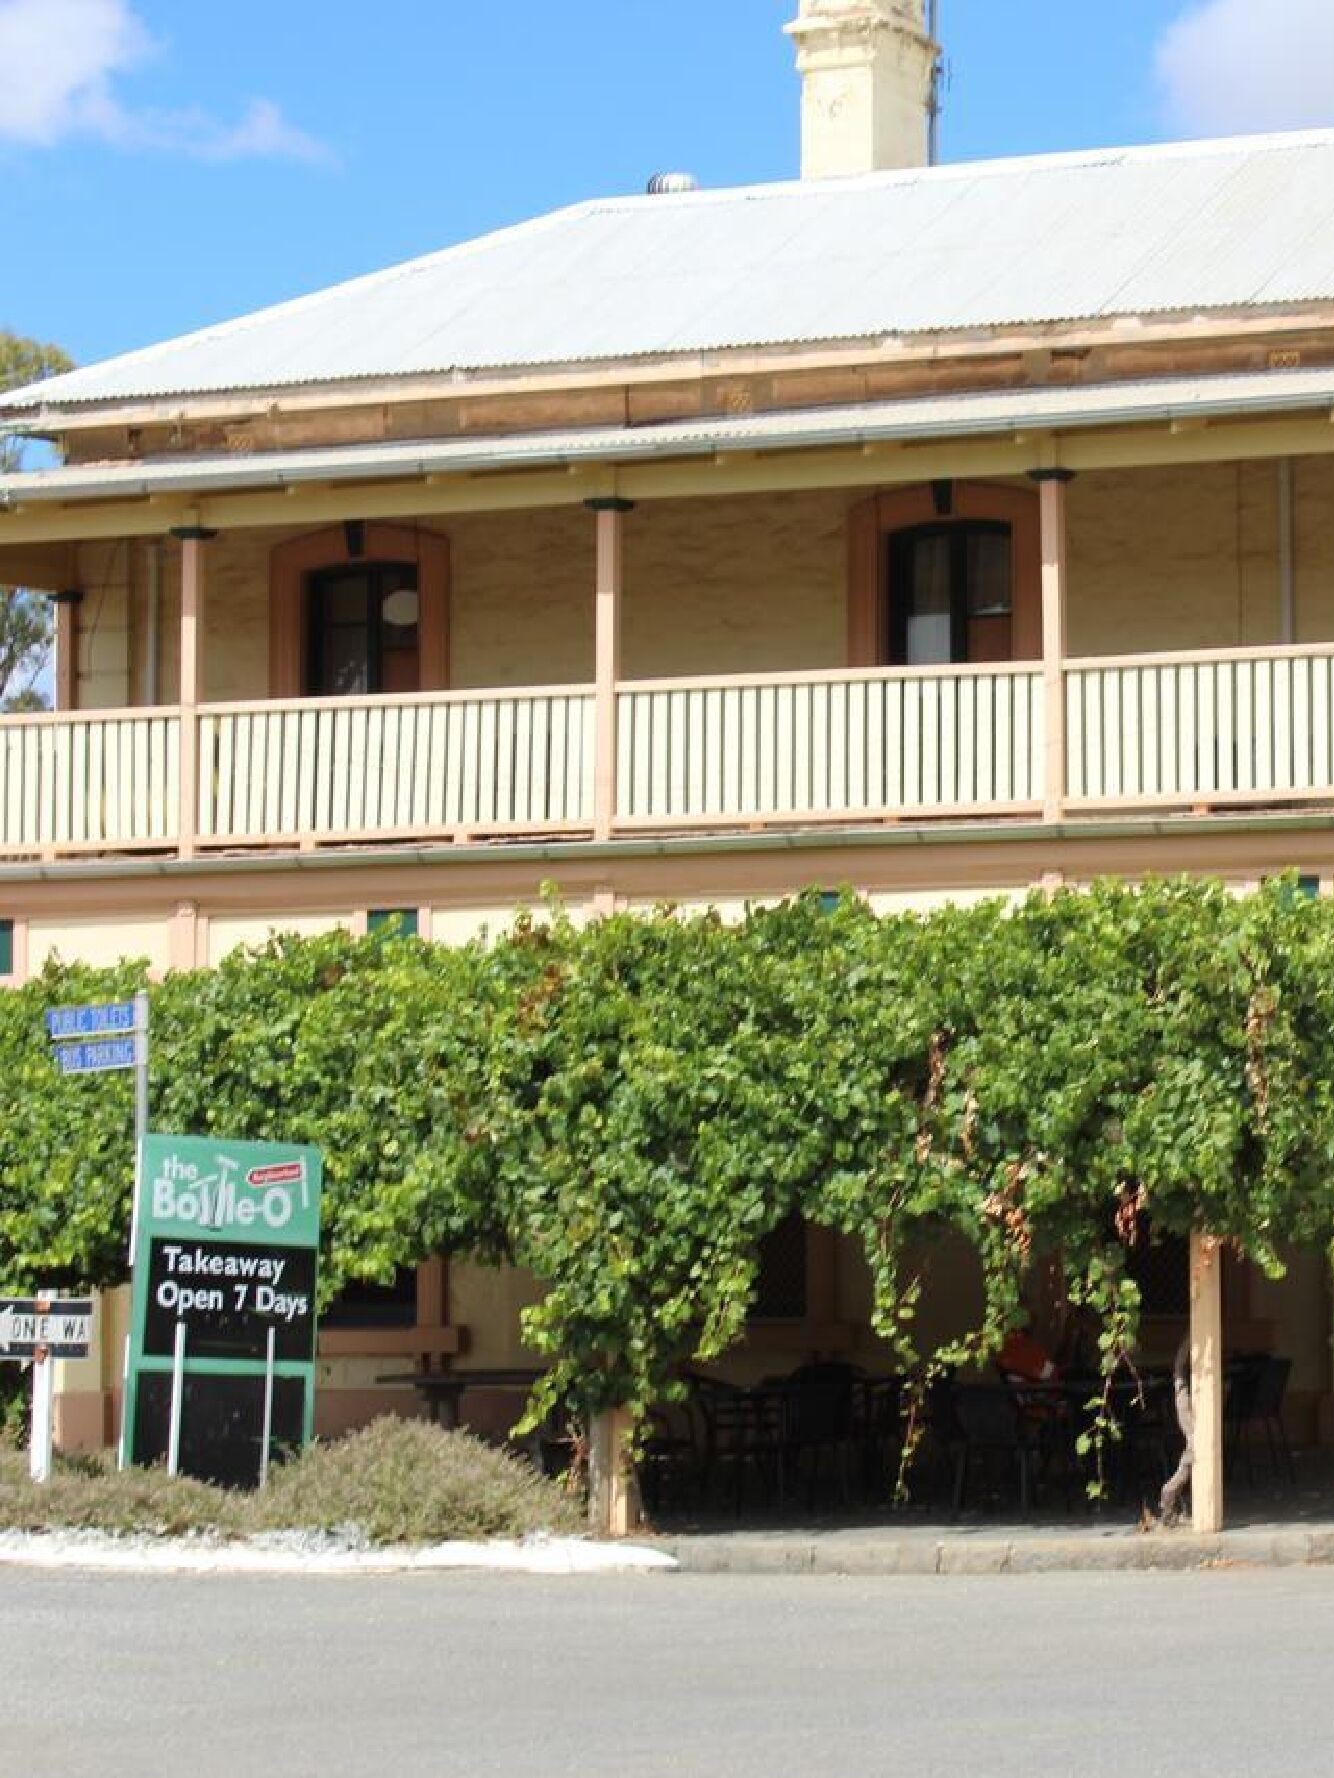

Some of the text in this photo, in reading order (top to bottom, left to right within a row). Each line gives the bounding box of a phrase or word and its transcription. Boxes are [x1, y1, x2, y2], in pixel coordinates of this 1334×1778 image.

[164, 1154, 198, 1179] the
[163, 1246, 286, 1286] Takeaway
[157, 1281, 309, 1323] Open 7 Days
[12, 1317, 48, 1338] ONE
